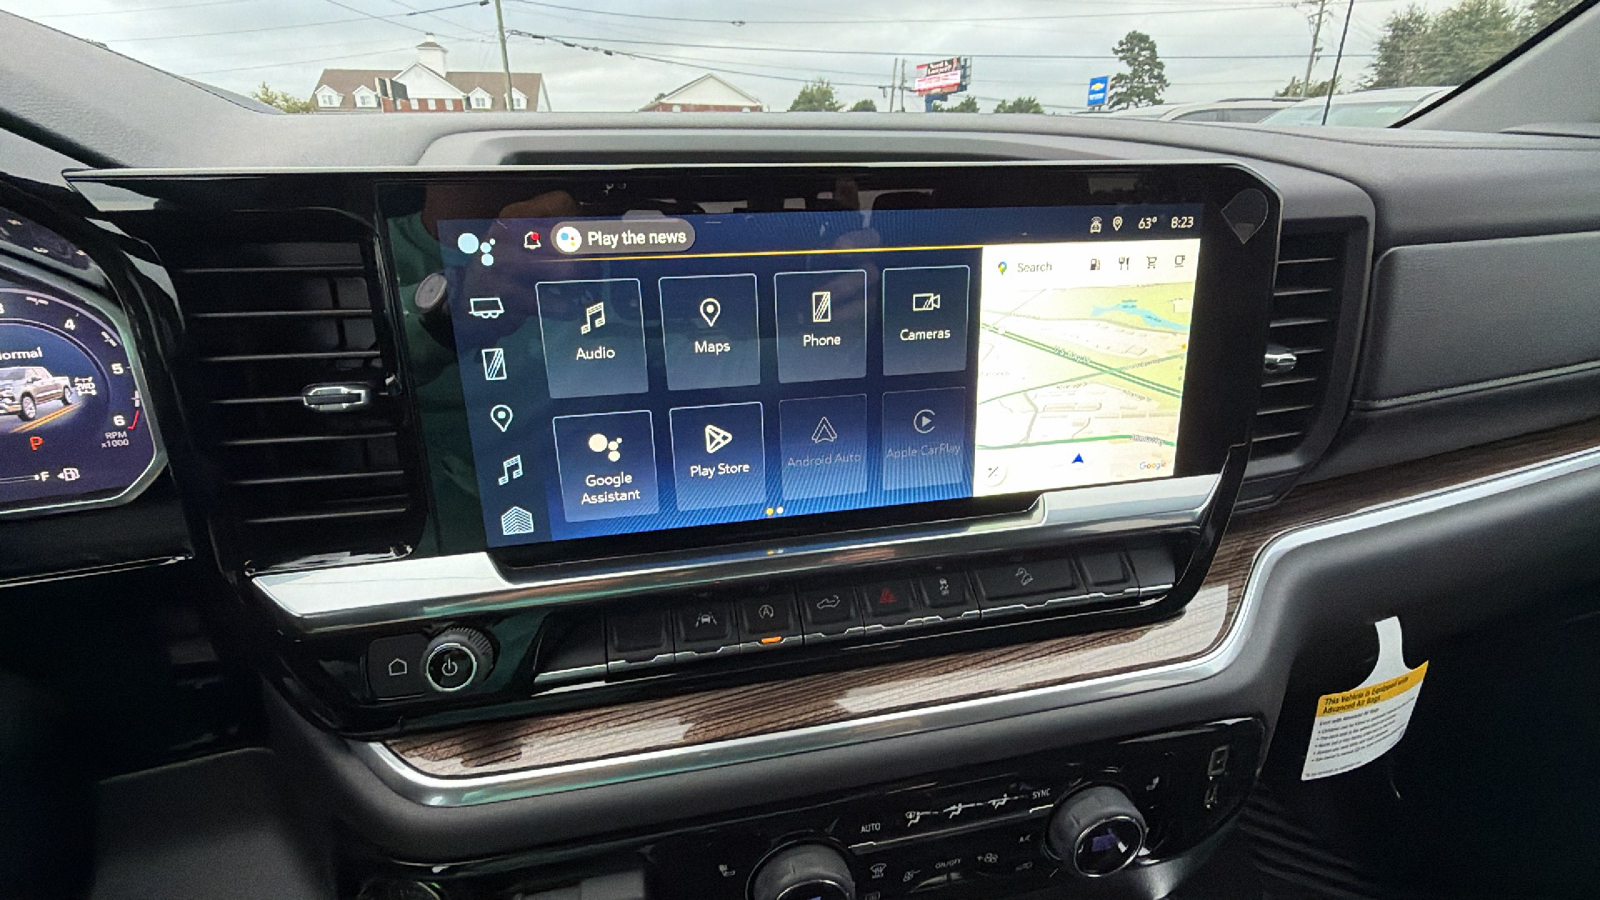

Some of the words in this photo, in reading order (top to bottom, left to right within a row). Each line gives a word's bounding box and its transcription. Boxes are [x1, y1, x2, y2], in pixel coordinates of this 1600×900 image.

[1138, 216, 1158, 230] 63°
[1170, 216, 1194, 229] 8:23
[587, 231, 619, 249] Play
[621, 230, 646, 244] the
[649, 232, 687, 244] news
[1017, 261, 1053, 273] Search
[64, 319, 76, 331] 4
[803, 333, 841, 348] Phone
[899, 327, 951, 341] Cameras
[0, 346, 43, 361] ormal
[575, 346, 616, 360] Audio
[694, 340, 731, 355] Maps
[111, 363, 124, 375] 5
[113, 415, 126, 426] 6
[105, 430, 128, 439] RPM
[30, 436, 44, 451] P
[101, 439, 130, 448] x1000
[886, 445, 918, 459] Apple
[920, 443, 961, 456] CarPlay
[787, 453, 832, 467] Android
[834, 453, 862, 464] Auto
[40, 471, 50, 482] F
[690, 465, 716, 479] Play
[717, 462, 750, 475] Store
[585, 471, 633, 488] Google
[581, 489, 641, 505] Assistant
[1325, 697, 1339, 705] This
[1341, 692, 1364, 703] Vehicle
[1323, 702, 1355, 714] Advanced
[1356, 699, 1366, 707] Air
[1032, 788, 1051, 799] SYNC
[860, 822, 881, 833] AUTO
